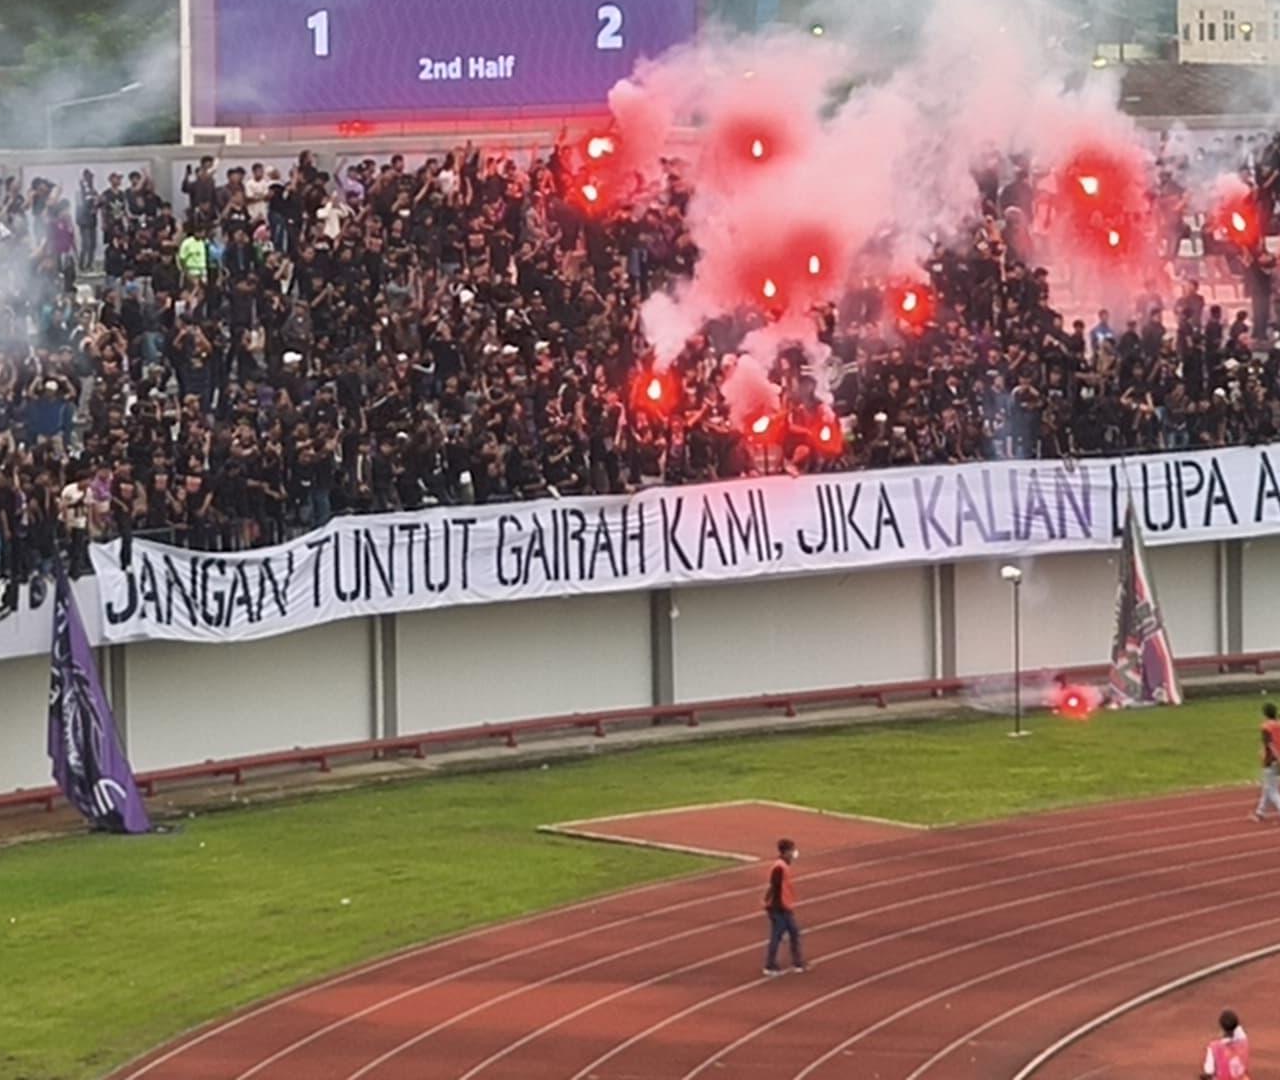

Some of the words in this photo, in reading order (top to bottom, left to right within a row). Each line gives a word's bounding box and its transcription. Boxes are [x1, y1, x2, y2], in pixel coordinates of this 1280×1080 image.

[307, 10, 329, 56] 1
[597, 5, 623, 49] 2
[418, 57, 462, 80] 2nd
[469, 56, 515, 79] Half
[106, 551, 294, 628] JANGAN
[307, 517, 477, 608] TUNTUT
[497, 502, 646, 586] GAIRAH
[660, 488, 785, 572] KAMI,
[797, 482, 905, 555] JIKA
[913, 465, 1094, 550] KALIAN
[1111, 456, 1238, 539] LUPA
